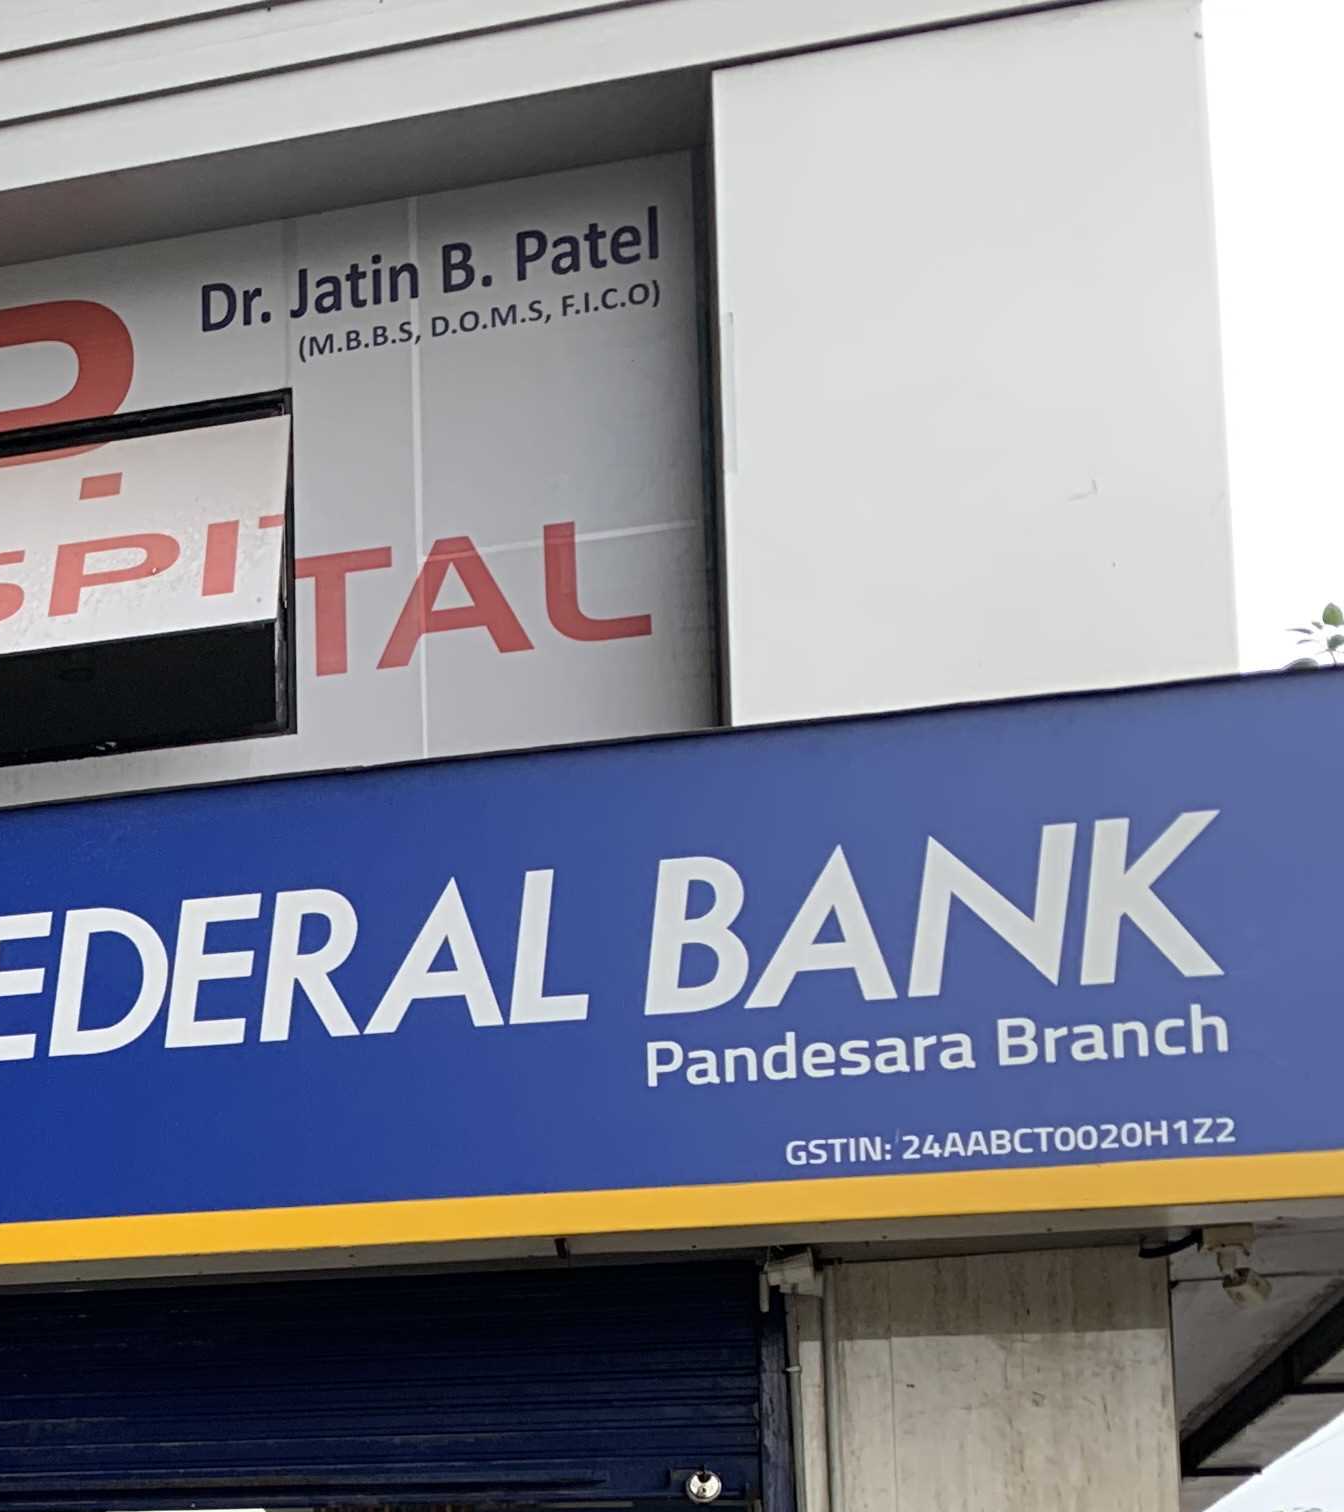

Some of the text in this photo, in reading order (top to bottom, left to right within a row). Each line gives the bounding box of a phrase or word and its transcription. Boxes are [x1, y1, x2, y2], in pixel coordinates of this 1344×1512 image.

[201, 205, 660, 332] Dr. Jatin B. Patel
[298, 278, 661, 364] (M.B.B.S, D.O.M.S, F.I.C.O)
[644, 808, 1225, 1017] BANK
[645, 1003, 1229, 1088] Pandesara Branch
[784, 1116, 1237, 1167] GSTIN: 24AABCT0020H1Z2
